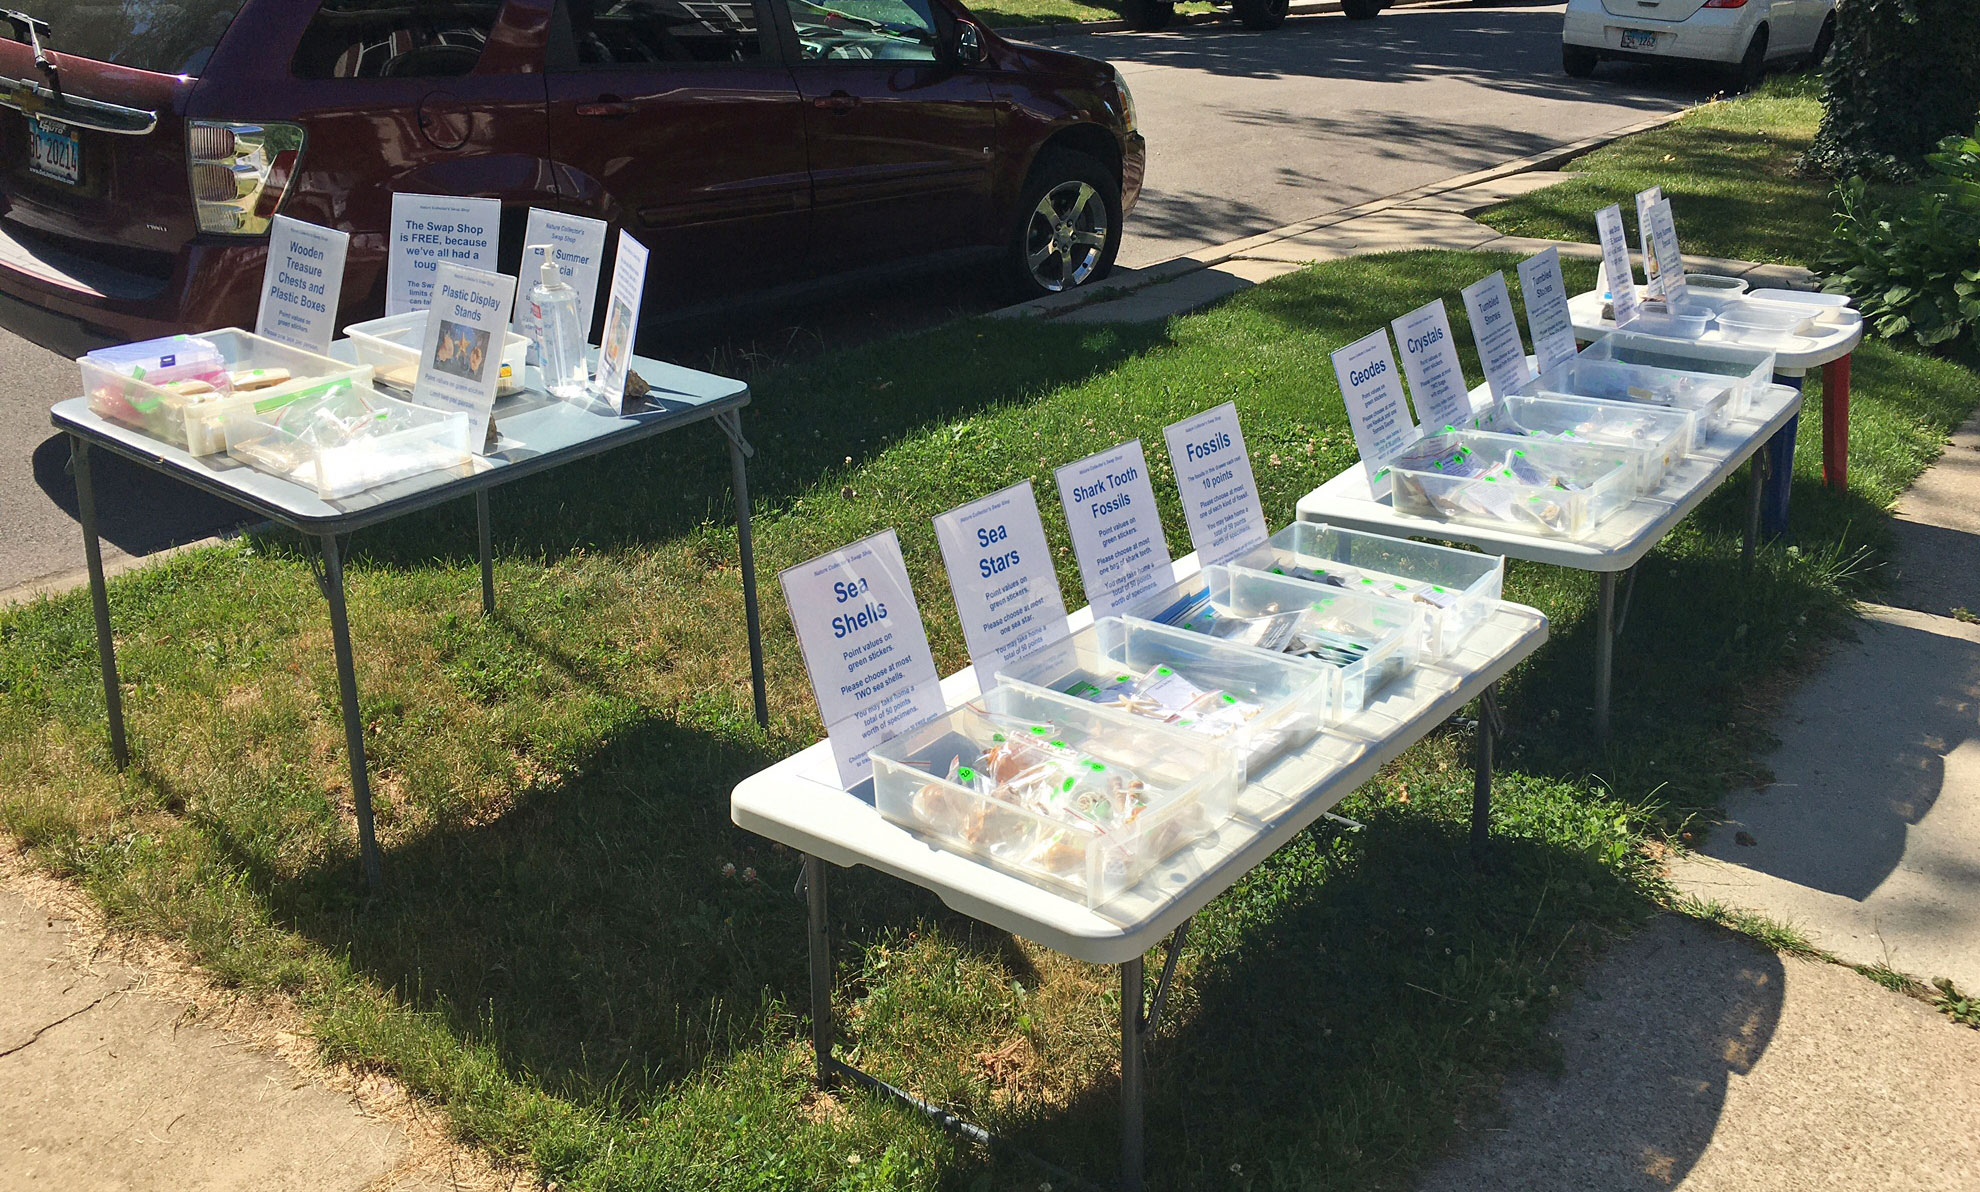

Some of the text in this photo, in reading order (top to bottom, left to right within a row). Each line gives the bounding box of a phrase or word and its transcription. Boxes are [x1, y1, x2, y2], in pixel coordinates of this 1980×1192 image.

[47, 137, 76, 172] 20214
[406, 220, 483, 235] The Swap Shop
[546, 223, 584, 235] Nature Collector's
[552, 233, 576, 244] Swap Shop
[290, 241, 323, 260] Wooden
[400, 233, 487, 247] is FREE, because
[406, 247, 434, 256] we've
[438, 249, 448, 257] all
[452, 250, 470, 259] had
[556, 250, 589, 264] Summer
[287, 257, 322, 277] Treasure
[414, 260, 436, 271] toug
[279, 272, 324, 295] Chests and
[408, 280, 419, 288] The
[271, 286, 325, 312] Plastic Boxes
[442, 285, 500, 311] Plastic Display
[1479, 295, 1499, 313] Tumbled
[455, 305, 481, 321] Stands
[1407, 326, 1443, 354] Crystals
[1350, 359, 1386, 387] Geodes
[1186, 432, 1231, 462] Fossils
[1073, 467, 1138, 503] Shark Tooth
[1202, 470, 1233, 489] 10 points
[1092, 492, 1131, 518] Fossils
[977, 524, 1007, 548] Sea
[1099, 526, 1113, 537] Point
[1113, 521, 1129, 531] values
[1097, 554, 1114, 565] Please
[1115, 546, 1132, 557] choose
[1138, 537, 1150, 547] most
[1102, 536, 1117, 547] green
[979, 550, 1020, 578] Stars
[1100, 567, 1109, 575] one
[1126, 552, 1139, 563] shark
[834, 577, 869, 603] Sea
[985, 587, 1002, 600] Point
[1002, 581, 1019, 592] values
[989, 587, 1029, 611] green stickers.
[832, 602, 887, 638] Shells
[983, 597, 1045, 632] Please choose at most
[1000, 615, 1035, 635] one sea star.
[843, 633, 893, 660] Point values on
[995, 646, 1006, 654] You
[1007, 640, 1018, 649] may
[1017, 635, 1028, 644] take
[1028, 628, 1042, 638] home
[1003, 650, 1015, 661] total
[1028, 636, 1043, 650] points
[848, 645, 895, 672] green stickers.
[841, 655, 912, 695] Please choose at most
[855, 672, 904, 700] TWO sea shells.
[855, 710, 867, 720] You
[868, 703, 881, 713] may
[881, 697, 893, 706] take
[893, 688, 910, 700] home
[863, 698, 911, 726] total of 50 points
[862, 723, 879, 738] worth
[880, 720, 887, 729] of
[887, 706, 918, 725] specimens.
[961, 770, 970, 778] 20
